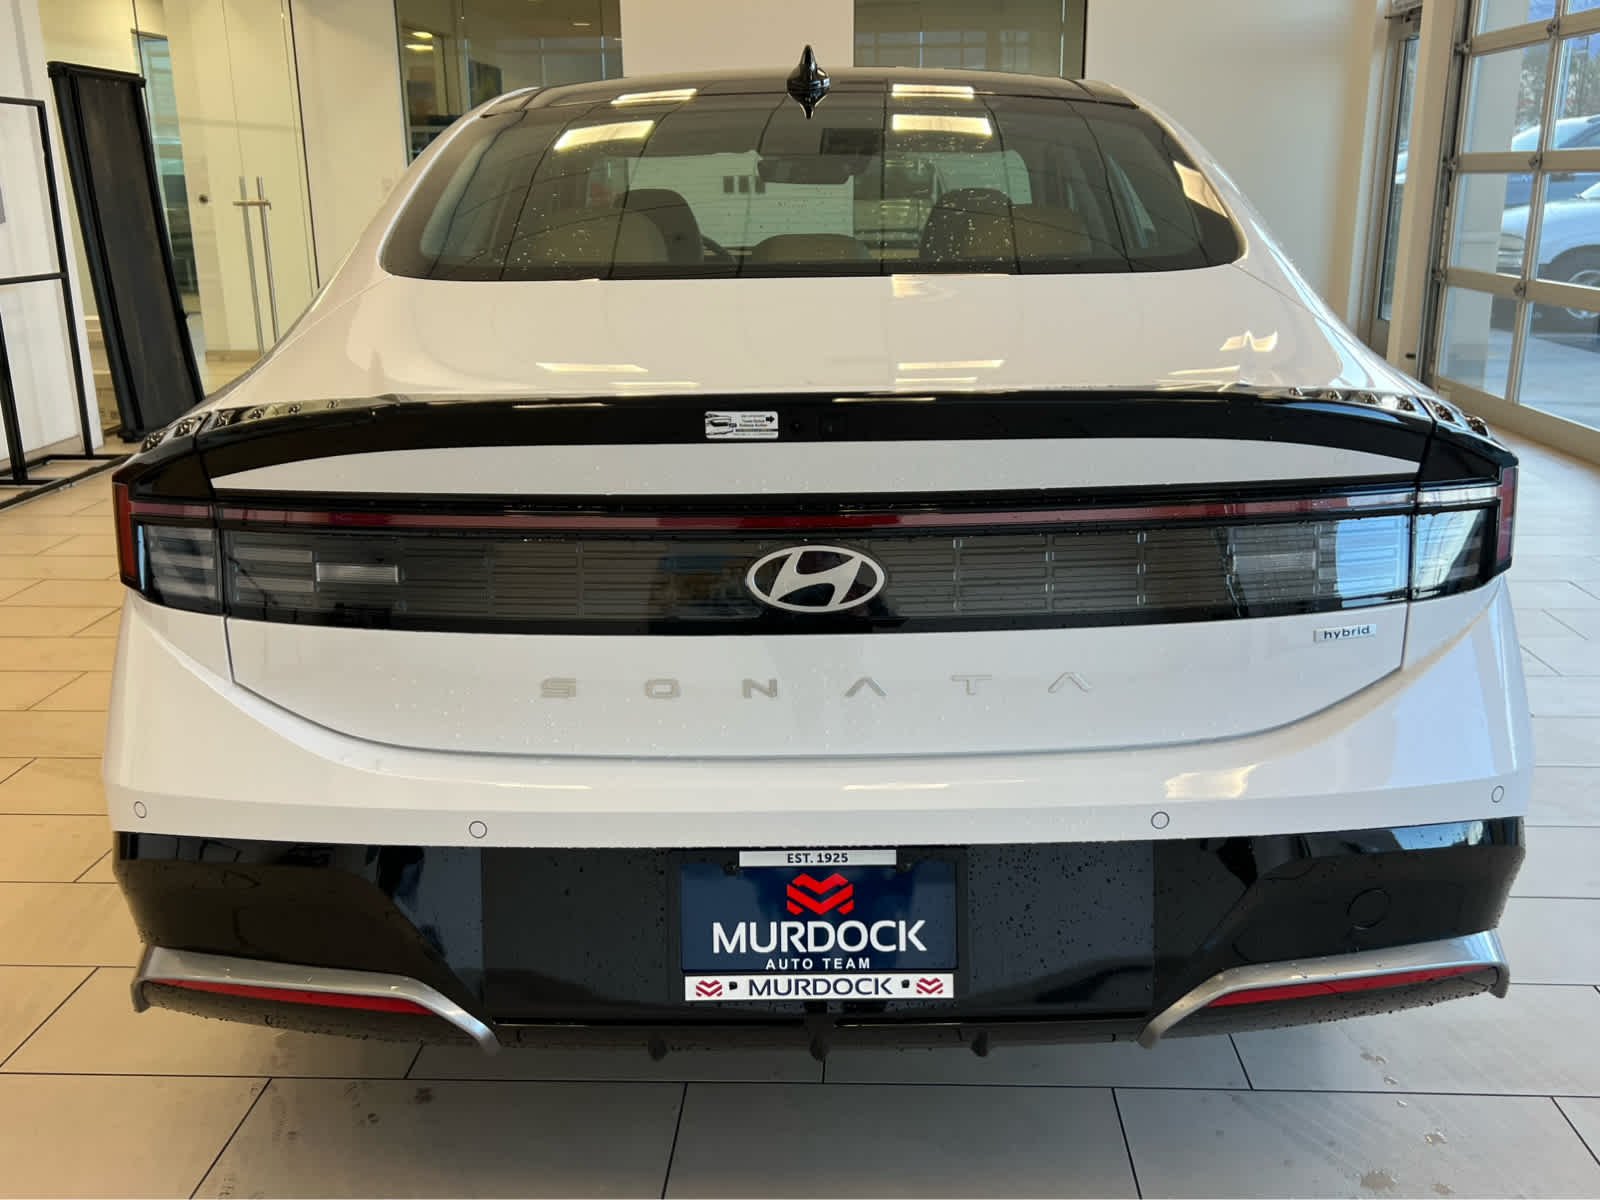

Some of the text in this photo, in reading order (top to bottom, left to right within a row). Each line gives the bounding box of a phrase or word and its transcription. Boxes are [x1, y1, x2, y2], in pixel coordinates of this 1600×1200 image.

[1323, 625, 1370, 640] hybrid
[787, 852, 849, 864] EST. 1925
[713, 920, 927, 953] MURDOCK
[766, 957, 871, 970] AUTO TEAM
[748, 978, 893, 996] MURDOCK
